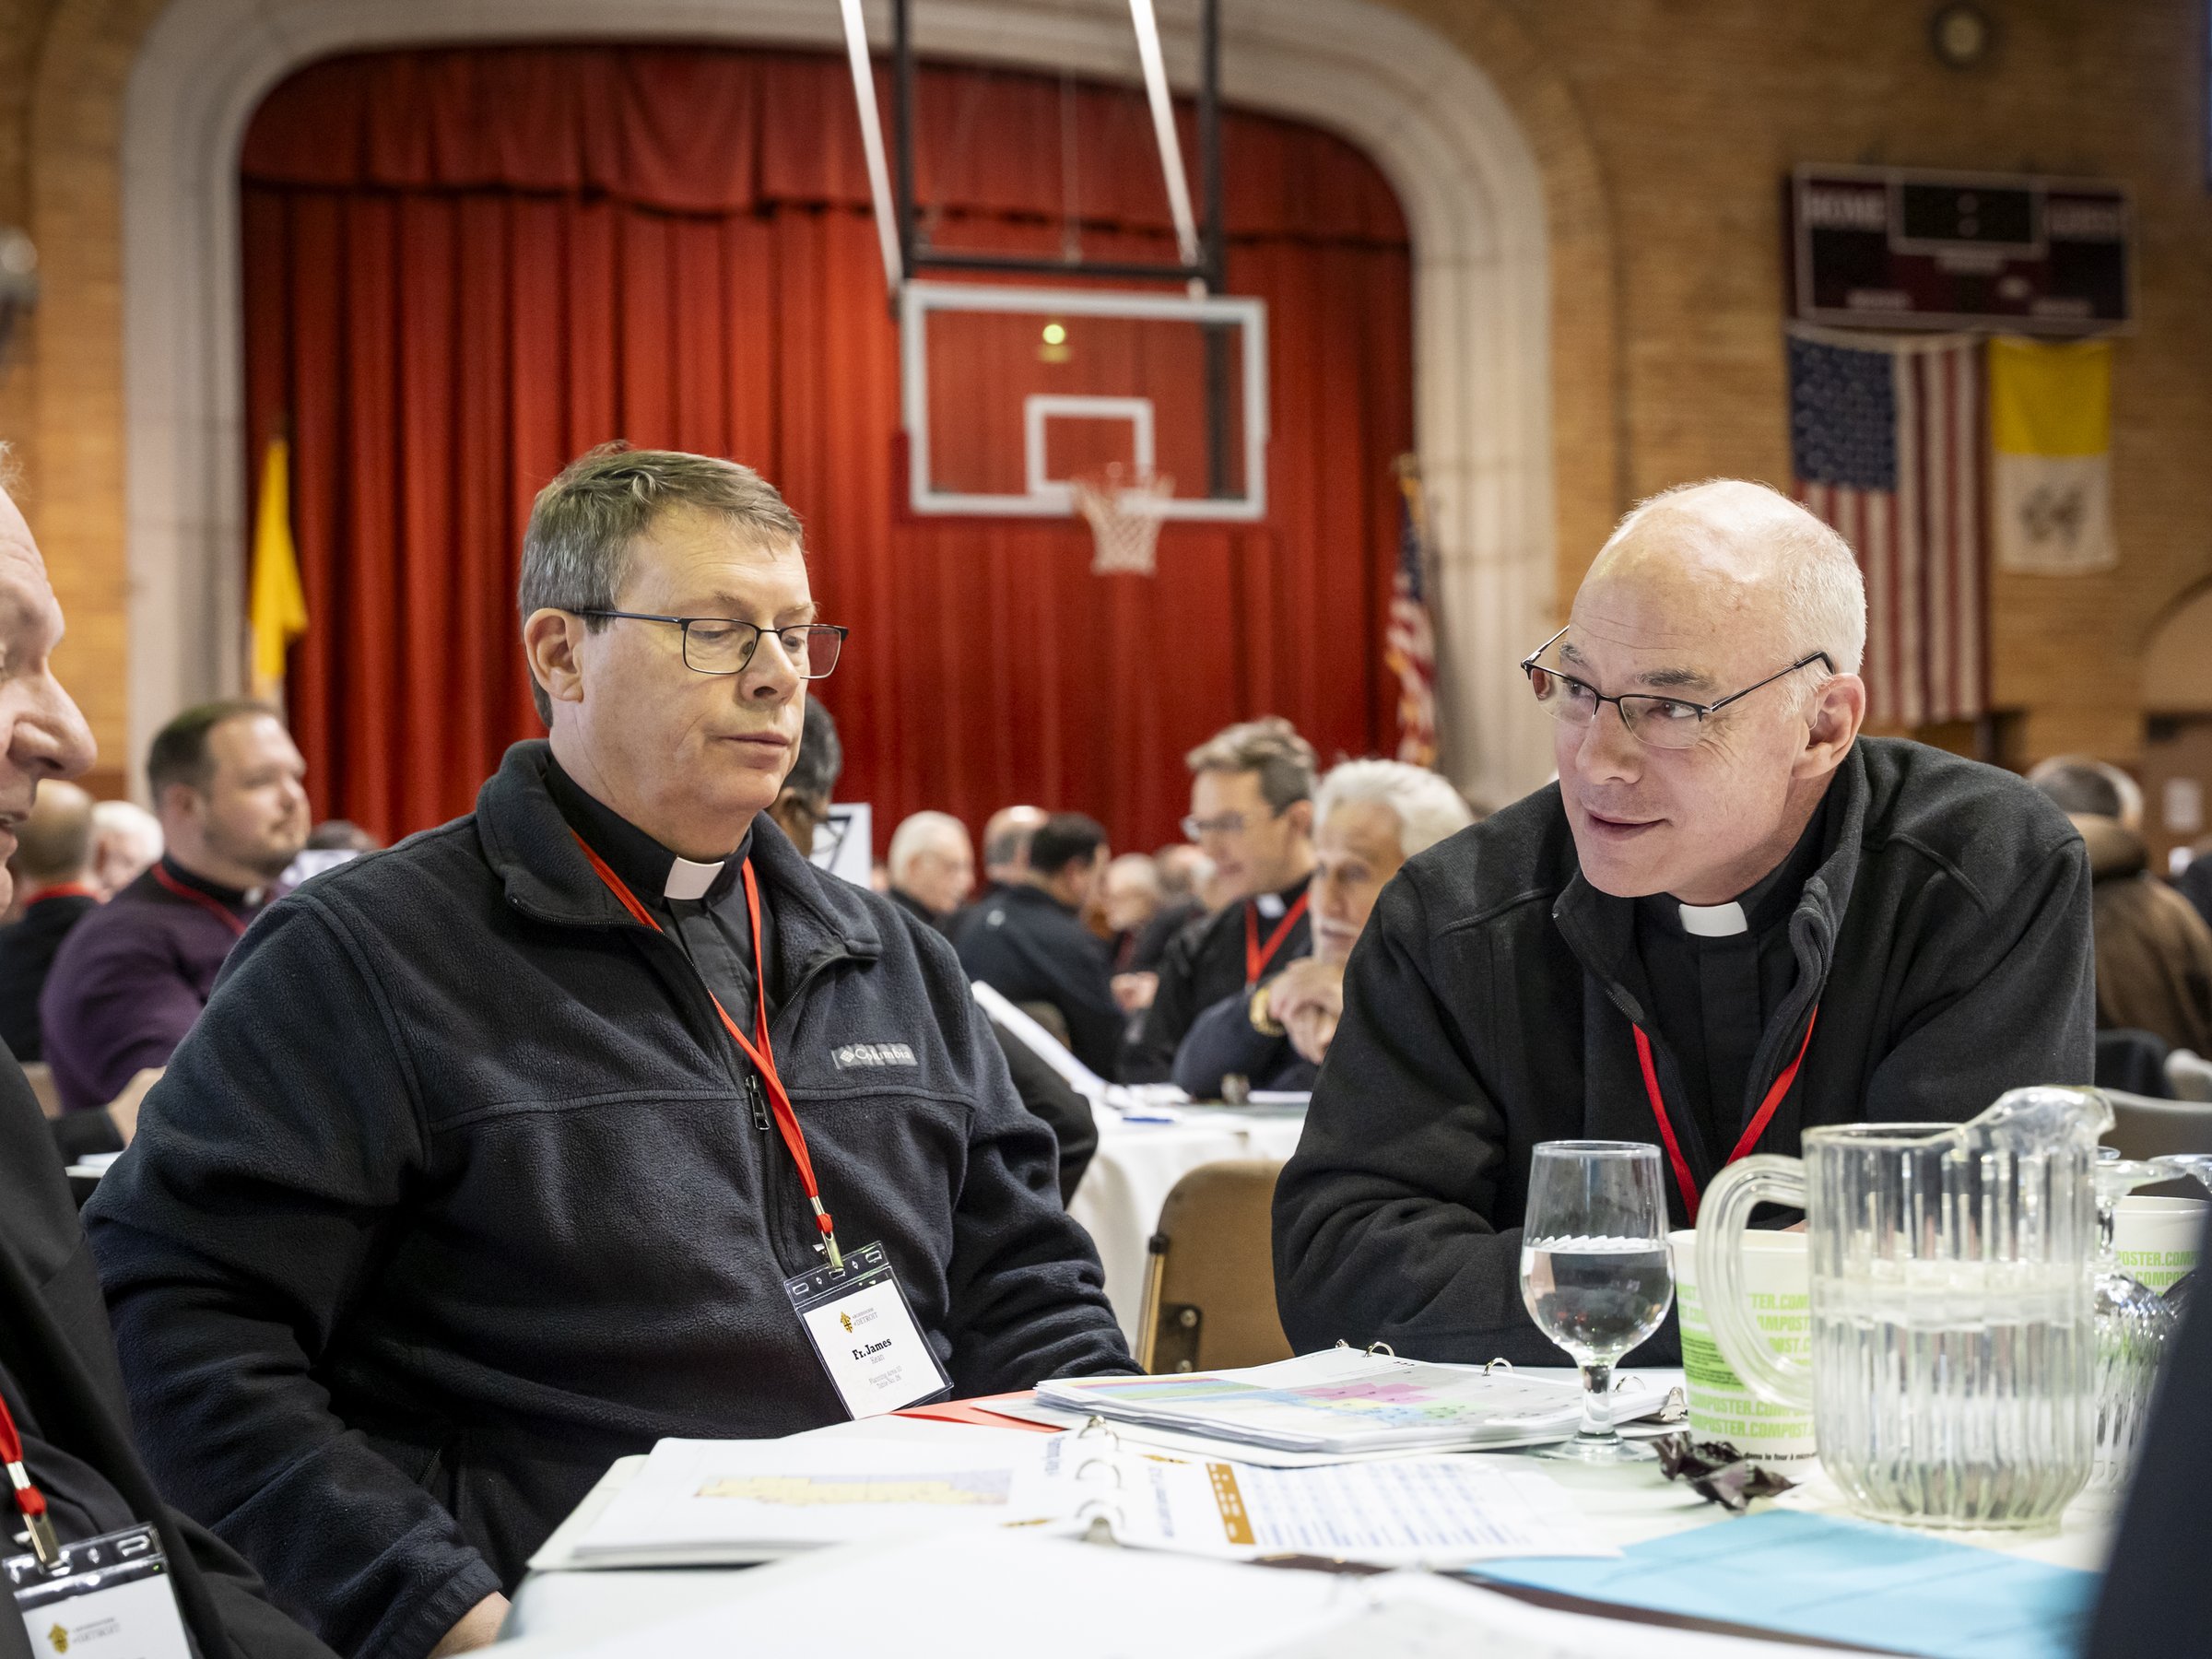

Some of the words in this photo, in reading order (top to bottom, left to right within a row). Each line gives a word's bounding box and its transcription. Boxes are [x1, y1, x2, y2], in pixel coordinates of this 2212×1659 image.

[854, 1048, 912, 1061] Columbia
[855, 1312, 878, 1326] DETROIT
[852, 1348, 866, 1360] Fr.
[865, 1338, 892, 1355] James
